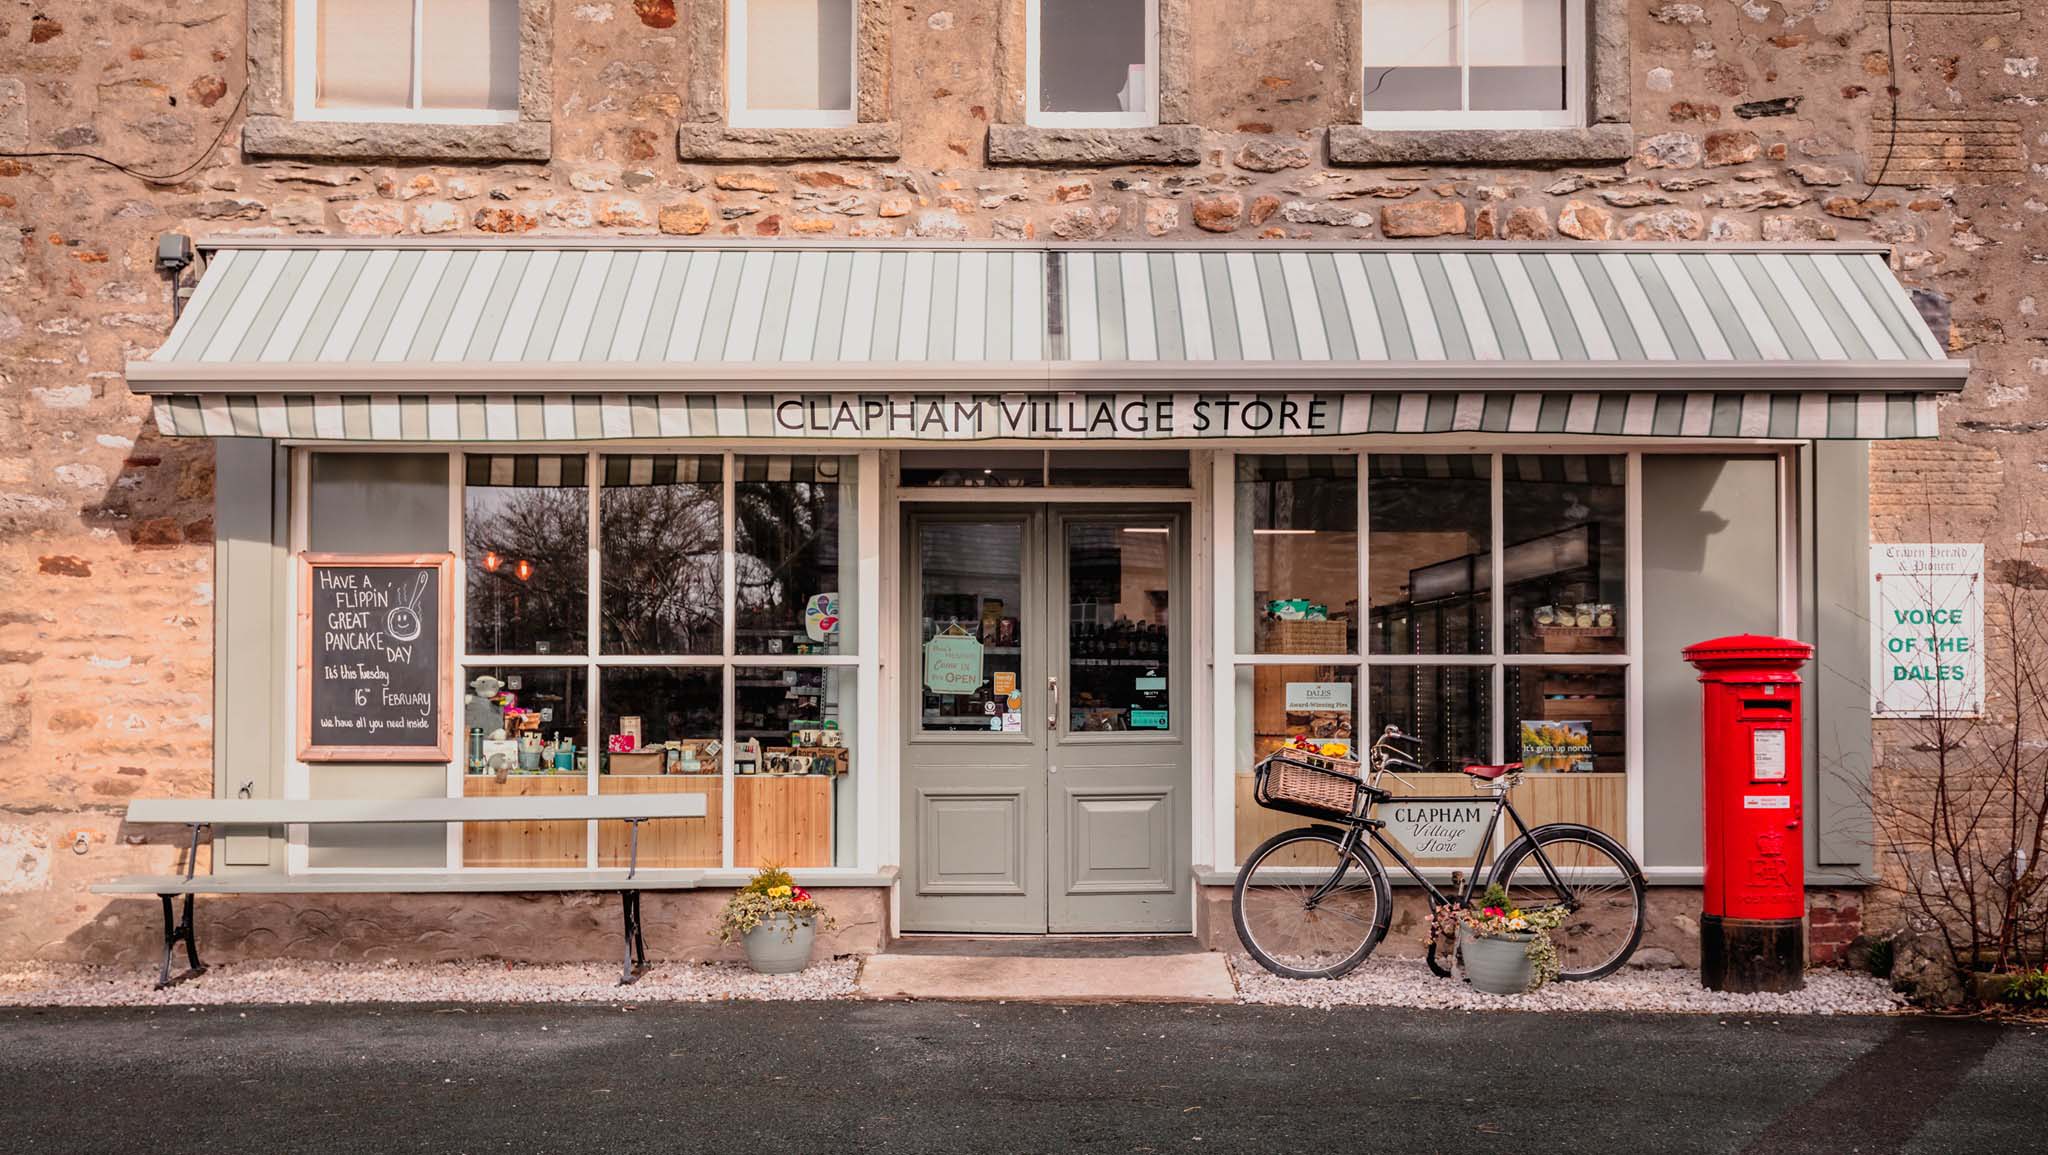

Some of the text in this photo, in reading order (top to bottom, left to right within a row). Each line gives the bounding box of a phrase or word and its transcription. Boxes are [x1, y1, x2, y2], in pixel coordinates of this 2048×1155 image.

[776, 400, 1327, 433] CLAPHAM VILLAGE STORE
[1886, 546, 1968, 558] Craven Herald
[1912, 560, 1955, 573] Pioneer
[320, 570, 372, 589] HAVE A
[328, 612, 370, 630] GREAT
[1894, 609, 1963, 625] VOICE
[325, 632, 384, 651] PANCAKE
[1888, 637, 1969, 653] OF THE
[386, 645, 412, 665] DAY
[324, 663, 390, 687] It's this Tuesday
[1893, 665, 1965, 681] DALES
[1306, 689, 1332, 697] DALES
[334, 715, 354, 728] have
[356, 716, 367, 728] all
[369, 720, 383, 734] you
[386, 716, 404, 728] need
[406, 717, 429, 729] inside
[1523, 743, 1592, 754] It's grim up north!
[1395, 808, 1480, 823] CLAPHAM
[1408, 822, 1466, 842] Village
[1416, 838, 1457, 853] Store
